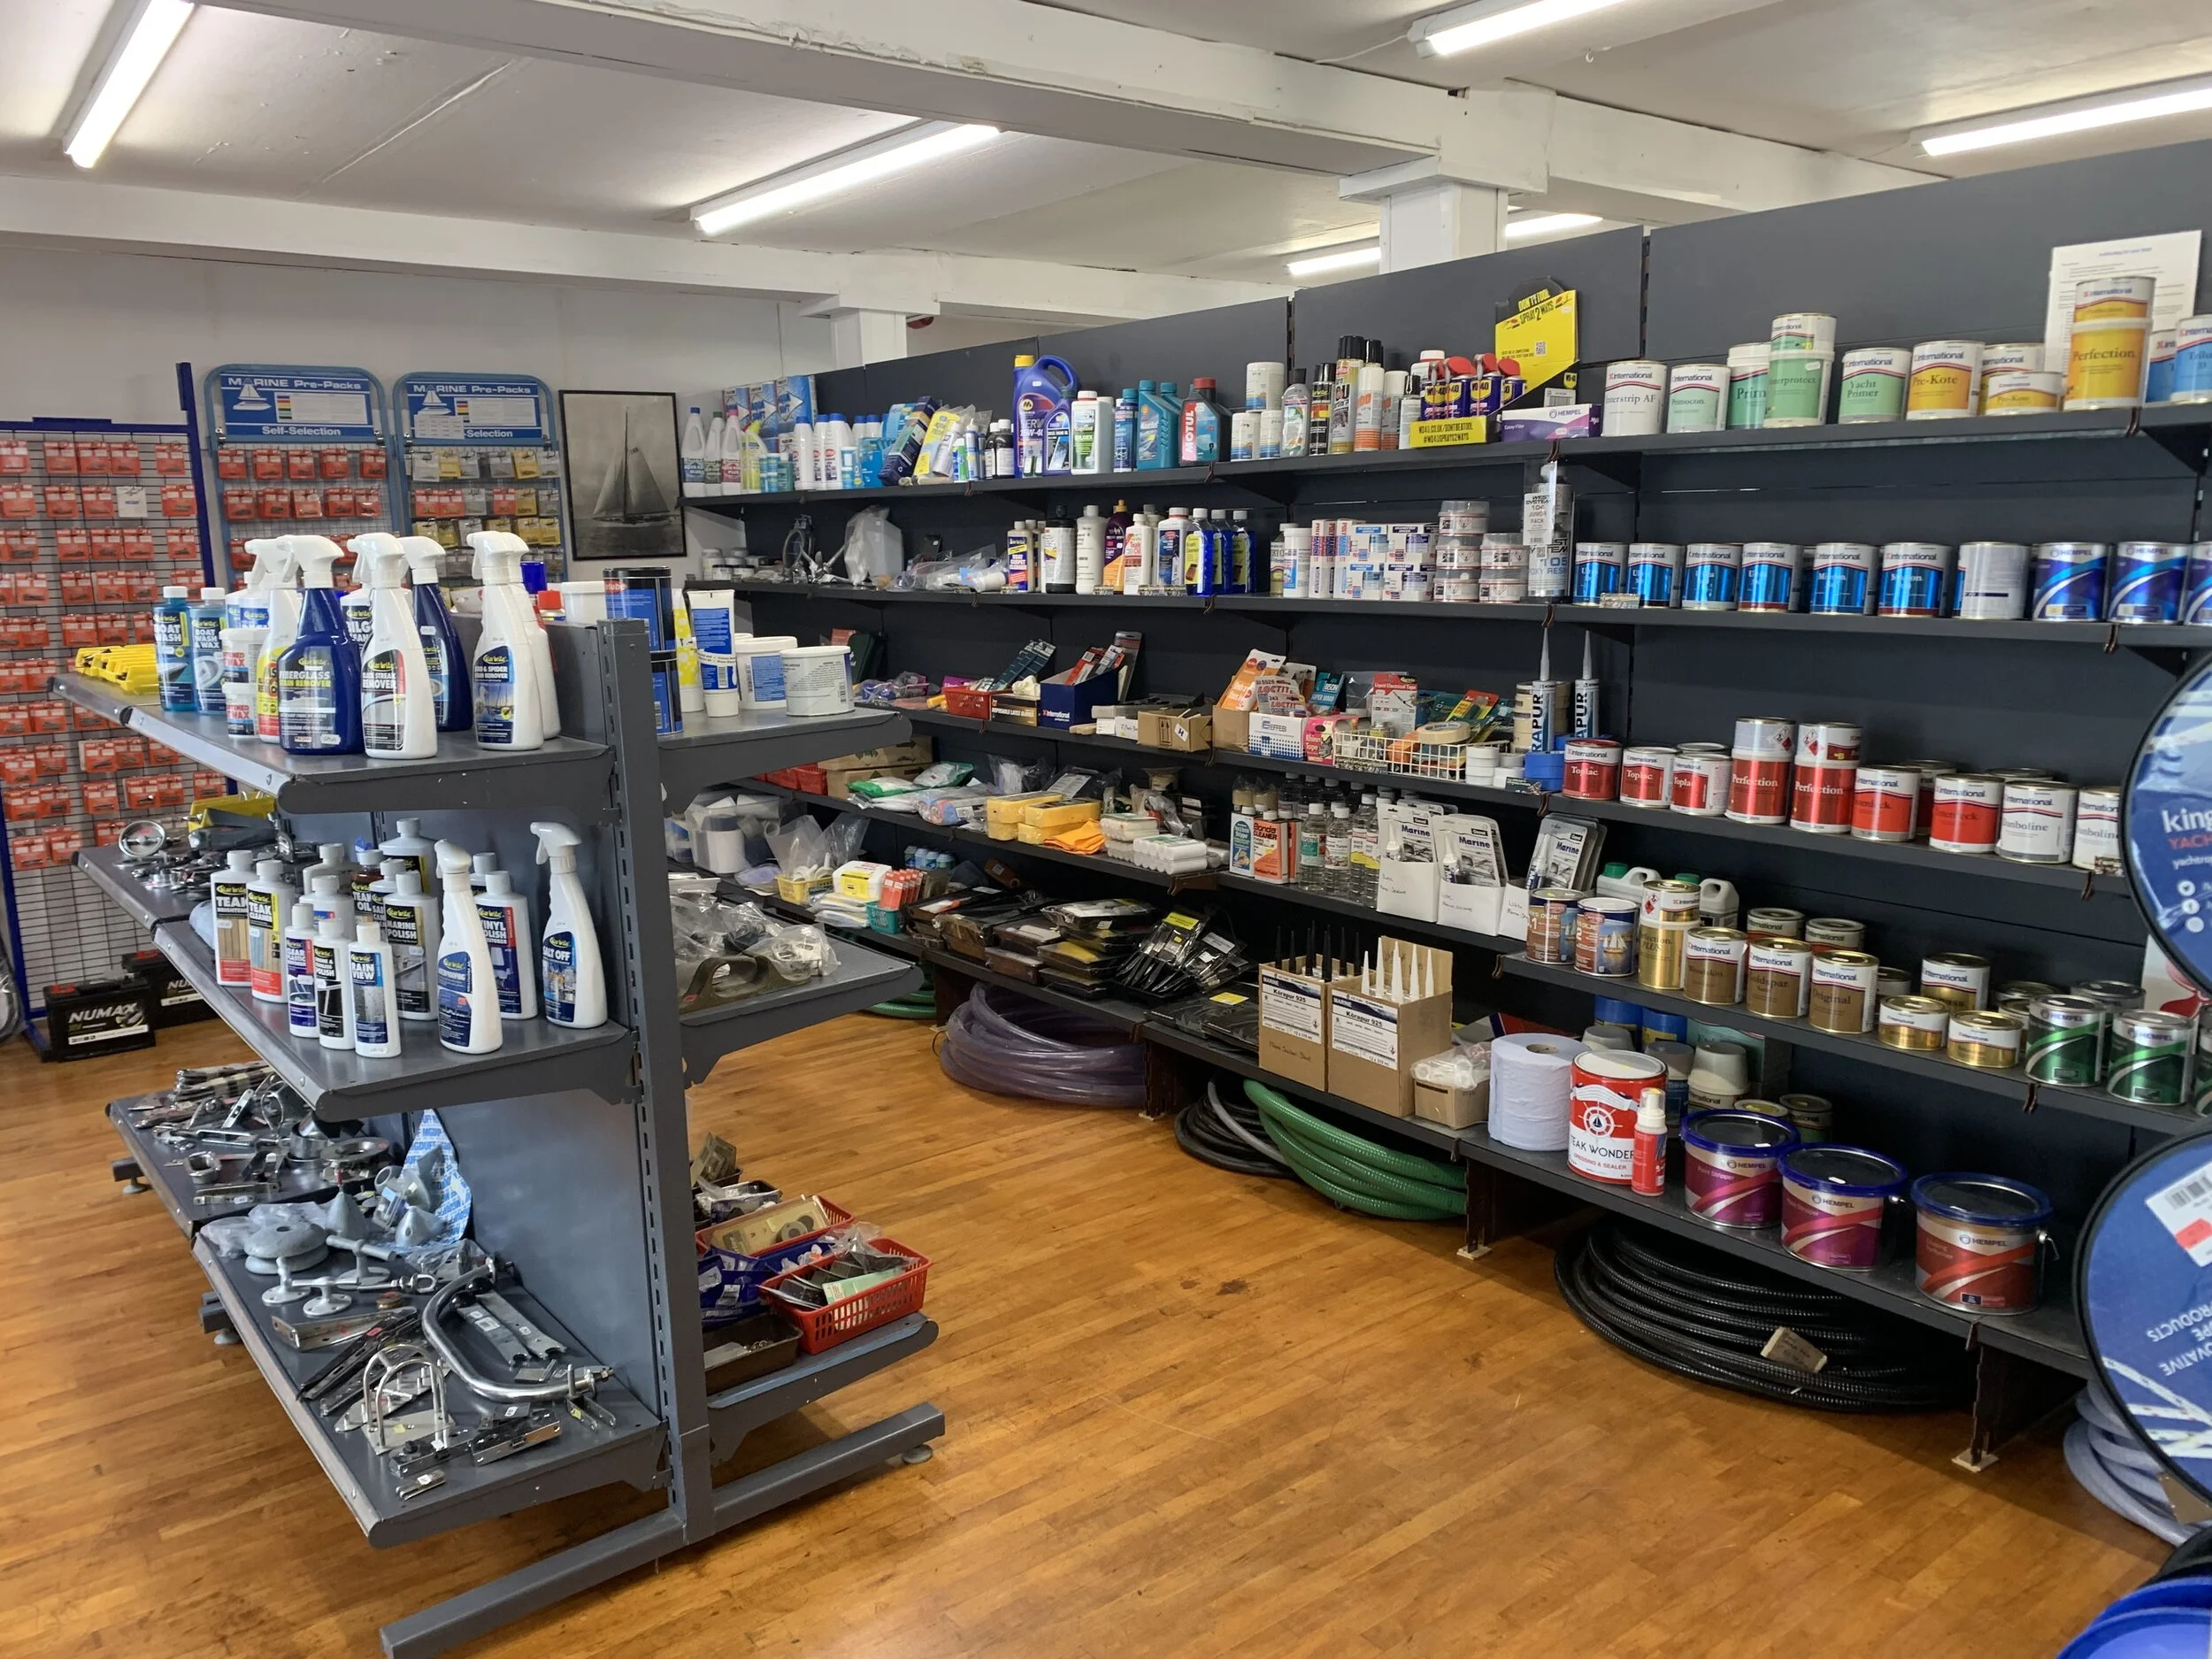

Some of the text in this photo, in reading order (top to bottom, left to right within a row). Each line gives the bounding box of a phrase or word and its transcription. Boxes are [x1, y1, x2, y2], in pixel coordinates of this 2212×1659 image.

[1535, 307, 1541, 321] 2
[1917, 351, 1964, 361] International
[2073, 349, 2136, 362] Perfection
[1849, 358, 1893, 367] International
[227, 378, 362, 390] MARINE Pre-Packs
[1850, 380, 1876, 389] Yacht
[1912, 375, 1958, 387] Pre-Kote
[413, 384, 467, 394] MARINE
[1738, 388, 1767, 399] Prim
[1847, 388, 1878, 398] Primer
[1643, 394, 1655, 403] AF
[262, 426, 341, 435] Self-Selection
[1186, 411, 1194, 454] MOTUL
[154, 625, 180, 634] BOAT
[155, 634, 182, 642] WASH
[280, 671, 331, 680] FIBERGLASS
[362, 680, 397, 689] REMOVER
[1048, 710, 1070, 718] International
[1576, 693, 1587, 737] APUR
[1532, 694, 1543, 752] RAPUR
[1306, 742, 1318, 751] Tape
[1732, 774, 1778, 787] Perfection
[1795, 781, 1844, 795] Perfection
[1939, 787, 1985, 797] International
[2006, 795, 2054, 806] International
[2080, 801, 2119, 812] Internation
[1254, 823, 1277, 833] Bonda
[1402, 825, 1431, 837] Marine
[2078, 826, 2119, 839] anbolin
[1254, 830, 1278, 840] CLEANER
[1459, 836, 1490, 849] Marine
[1556, 841, 1579, 855] Marine
[249, 902, 272, 915] TEAK
[357, 902, 373, 911] OIL
[387, 920, 416, 930] MARINE
[388, 929, 417, 940] POLISH
[485, 930, 507, 939] OLISH
[555, 949, 572, 961] OFF
[1691, 944, 1732, 955] International
[1752, 956, 1793, 966] International
[1815, 968, 1857, 981] International
[1924, 970, 1968, 983] International
[68, 1002, 137, 1023] NUMAX
[2050, 1011, 2084, 1022] HEMPEL
[2139, 1031, 2173, 1041] HEMPEL
[1571, 1134, 1587, 1152] TEAK
[1823, 1200, 1855, 1209] HEMPEL
[1972, 1238, 2008, 1248] HEMPEL
[2147, 1301, 2212, 1342] RODUCTS
